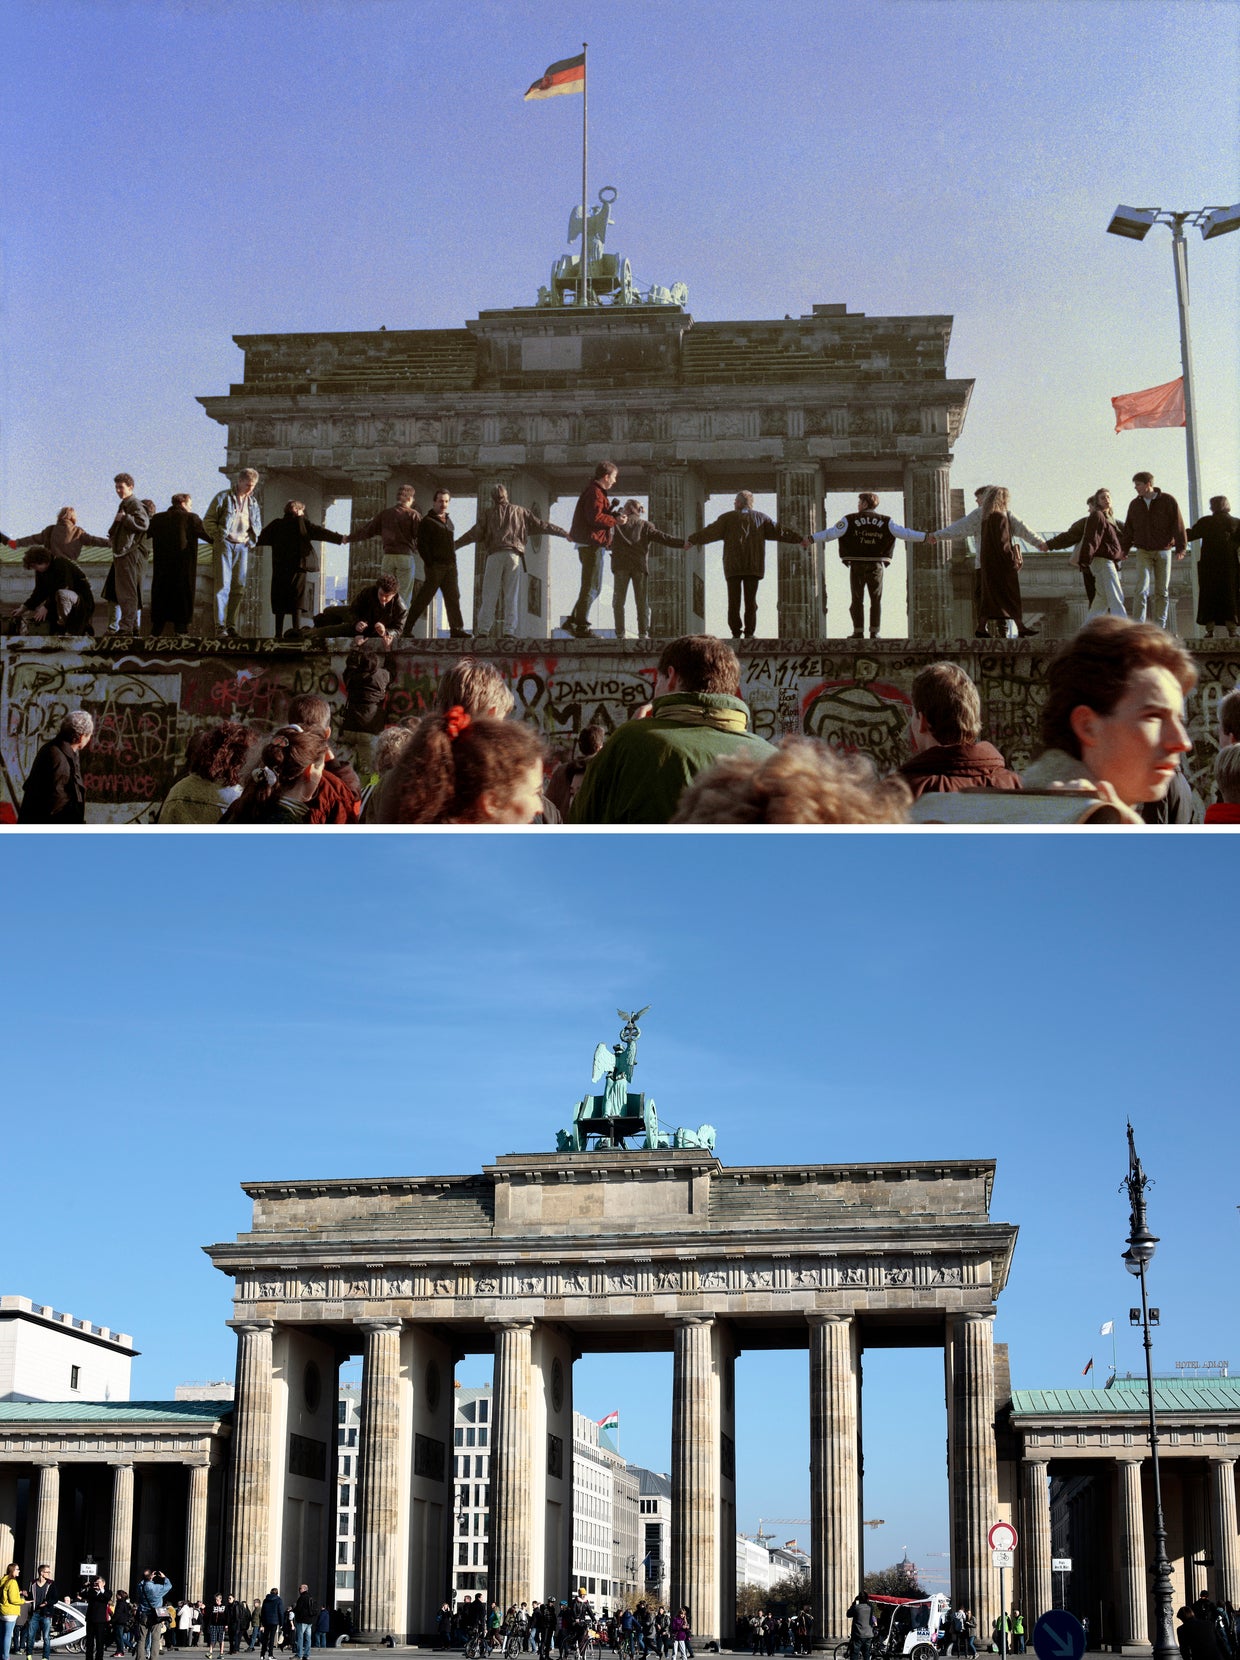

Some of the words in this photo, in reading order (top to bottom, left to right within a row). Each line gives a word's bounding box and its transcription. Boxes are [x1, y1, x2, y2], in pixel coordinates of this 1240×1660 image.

[555, 680, 620, 701] DAVID
[1175, 1360, 1200, 1369] HOTEL
[1202, 1360, 1229, 1369] ADLON
